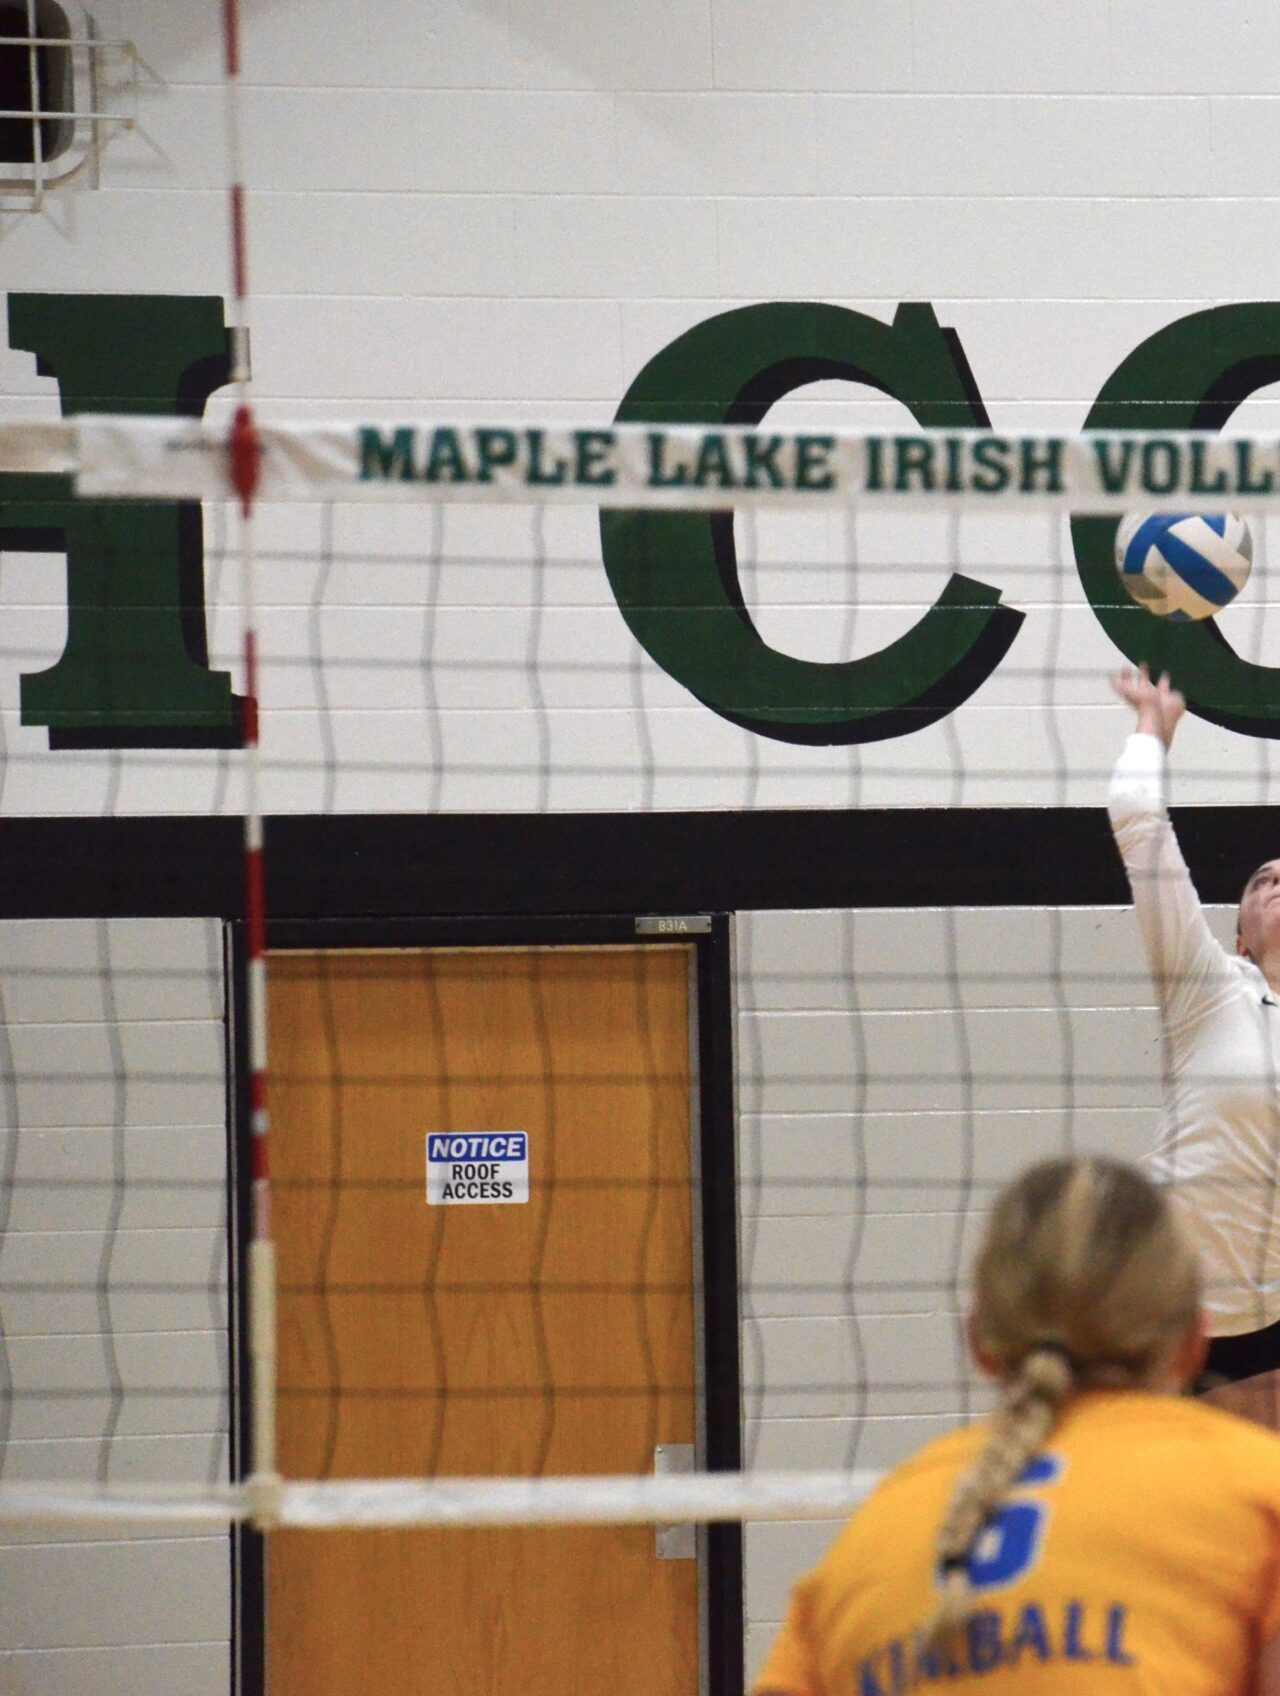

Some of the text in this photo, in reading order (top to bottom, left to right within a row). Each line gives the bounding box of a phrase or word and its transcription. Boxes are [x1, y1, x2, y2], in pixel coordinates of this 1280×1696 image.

[358, 427, 617, 486] MAPLE
[645, 432, 836, 490] LAKE
[864, 435, 1066, 494] IRISH
[431, 1136, 523, 1158] NOTICE
[451, 1163, 500, 1181] ROOF
[441, 1181, 513, 1199] ACCESS
